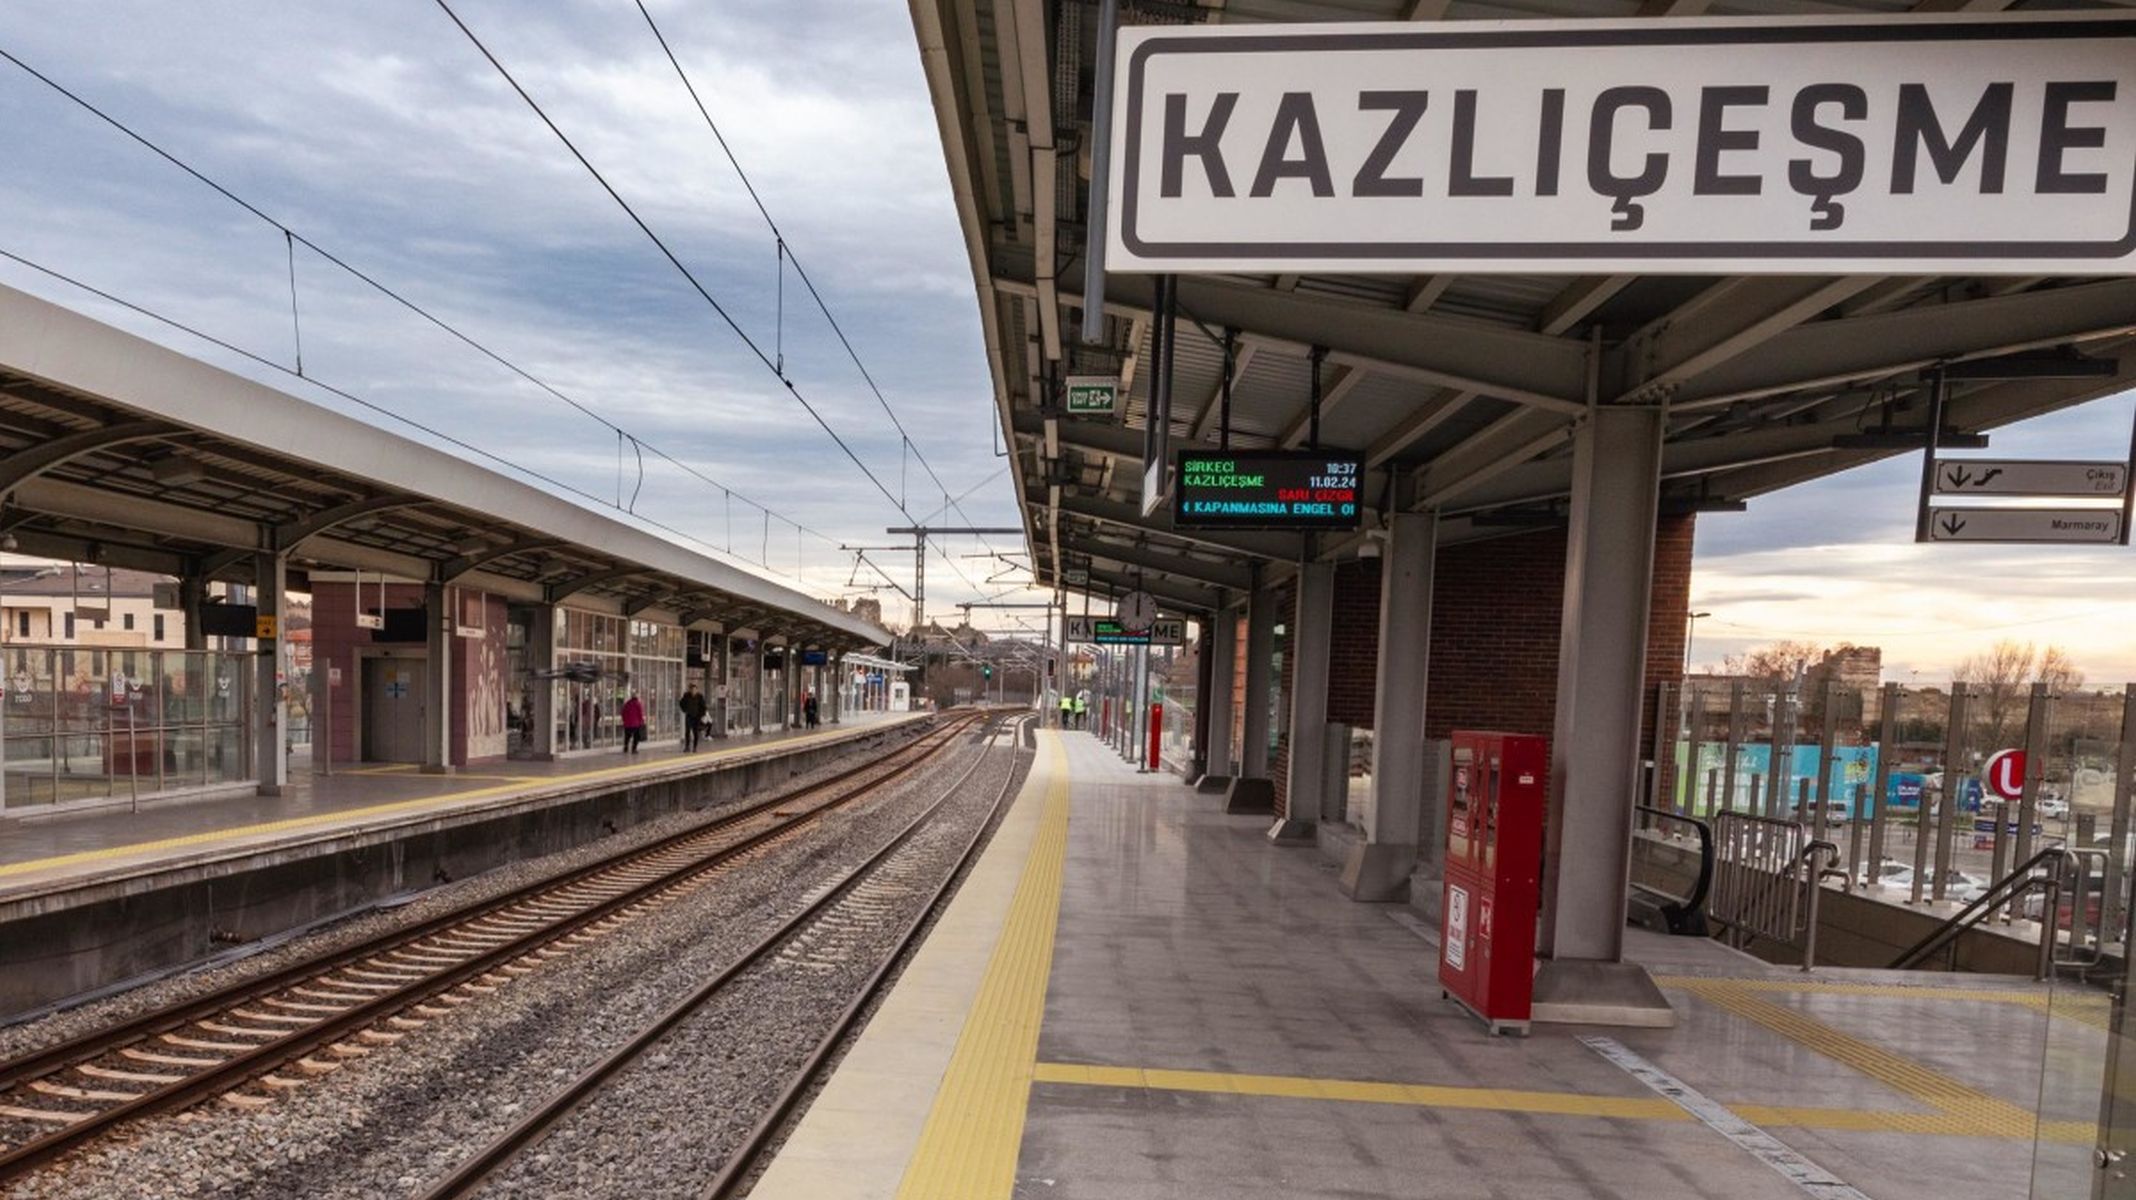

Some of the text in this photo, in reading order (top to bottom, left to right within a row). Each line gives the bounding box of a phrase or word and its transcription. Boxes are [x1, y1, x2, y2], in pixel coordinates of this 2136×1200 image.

[1159, 80, 2119, 233] KAZLIÇEŞME
[1309, 476, 1357, 488] 11.02.24
[1194, 502, 1287, 514] KAPANMASINA
[1293, 503, 1334, 515] ENGEL
[2051, 519, 2109, 533] Marmaray
